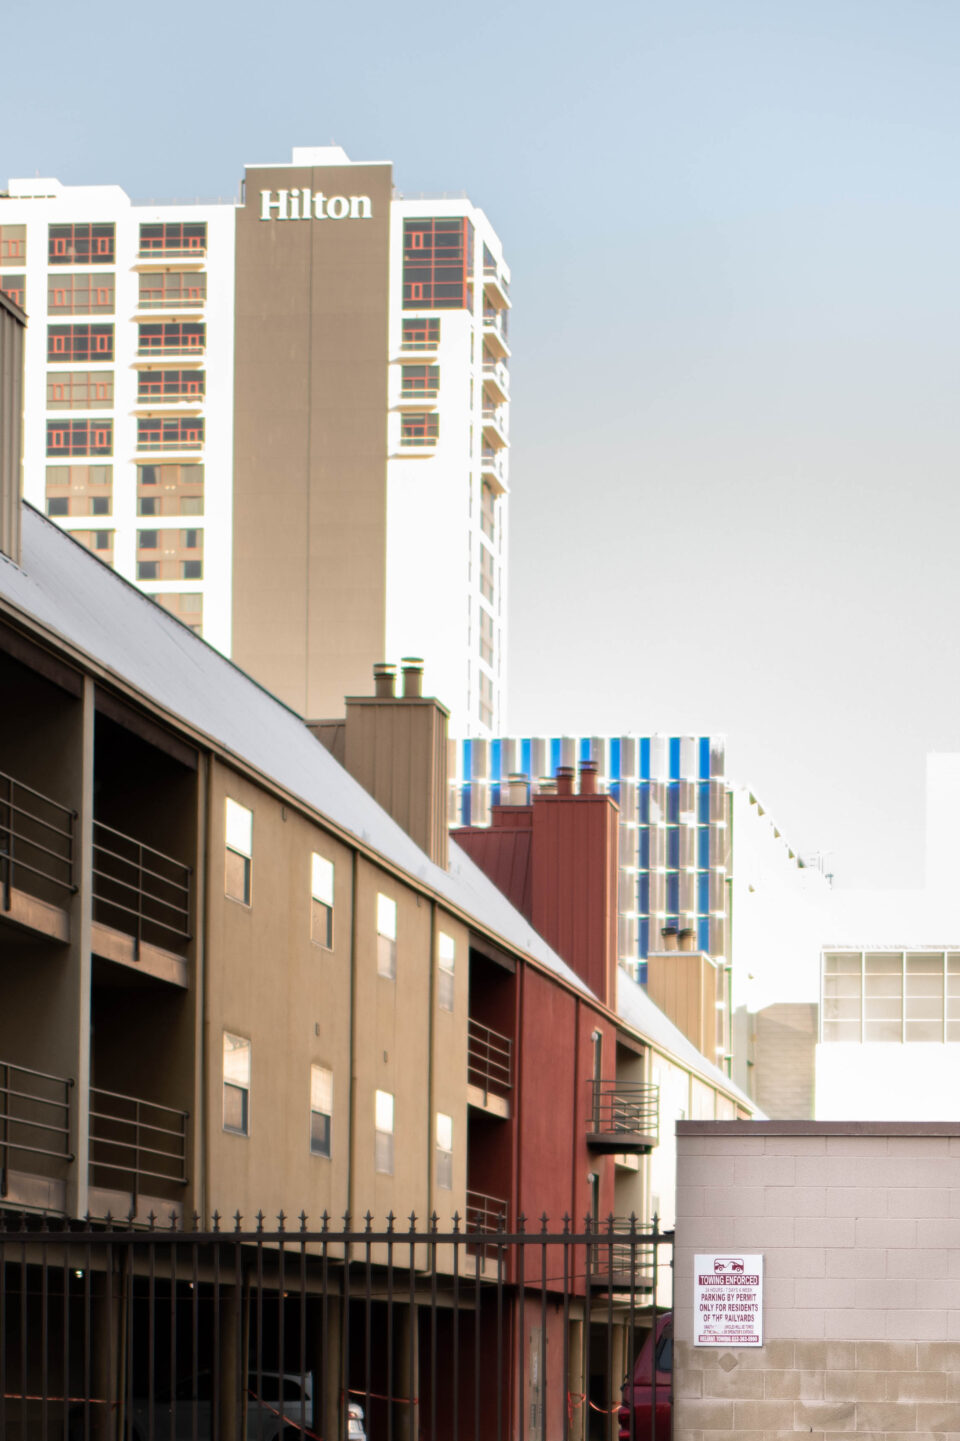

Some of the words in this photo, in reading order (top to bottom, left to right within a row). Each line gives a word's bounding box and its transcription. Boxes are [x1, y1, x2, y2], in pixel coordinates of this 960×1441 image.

[259, 187, 373, 221] Hilton
[701, 1276, 725, 1284] TOWING
[726, 1276, 758, 1284] ENFORCED
[701, 1293, 726, 1301] PARKING
[727, 1293, 735, 1301] BY
[736, 1293, 757, 1301] PERMIT
[703, 1314, 711, 1322] OF
